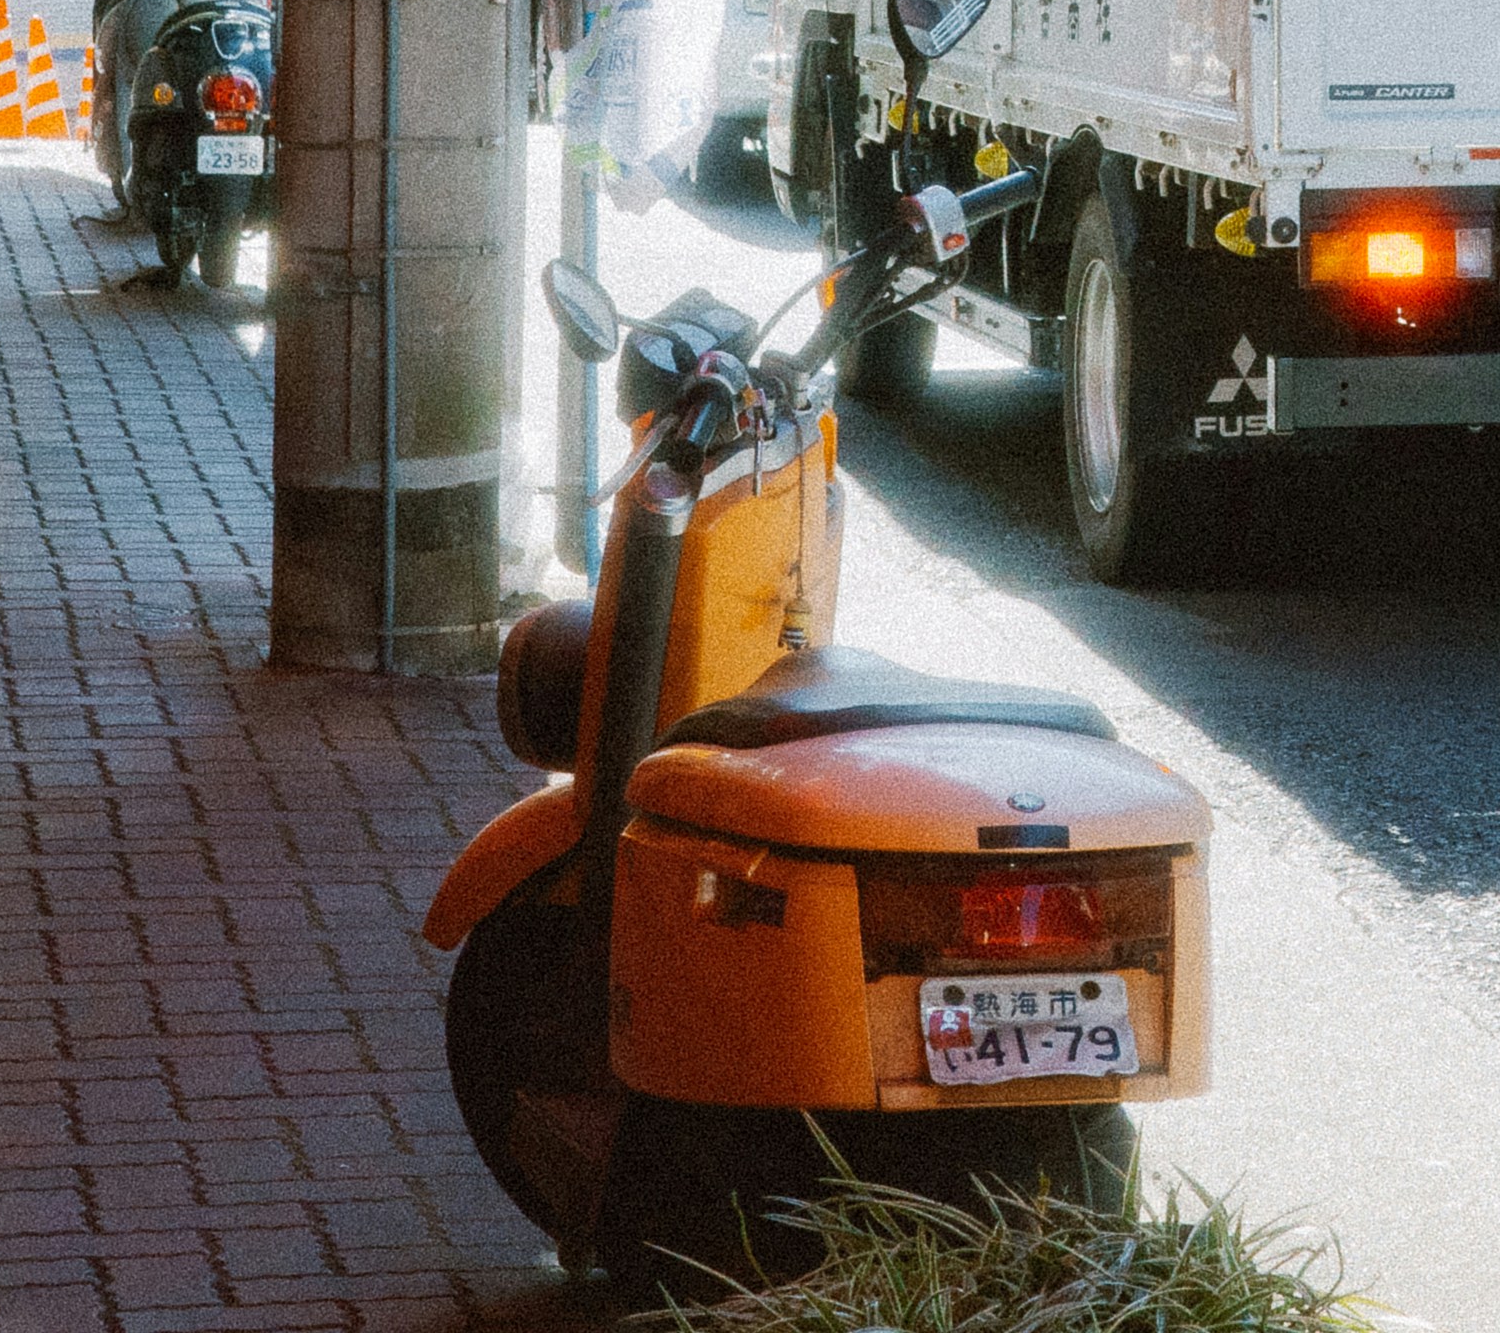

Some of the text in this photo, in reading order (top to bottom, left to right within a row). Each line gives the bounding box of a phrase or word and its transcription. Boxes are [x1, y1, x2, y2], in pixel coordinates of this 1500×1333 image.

[1375, 87, 1450, 98] CANTER
[1194, 415, 1297, 439] FUS
[973, 989, 1079, 1018] 熱海市
[974, 1024, 1121, 1069] 41-79
